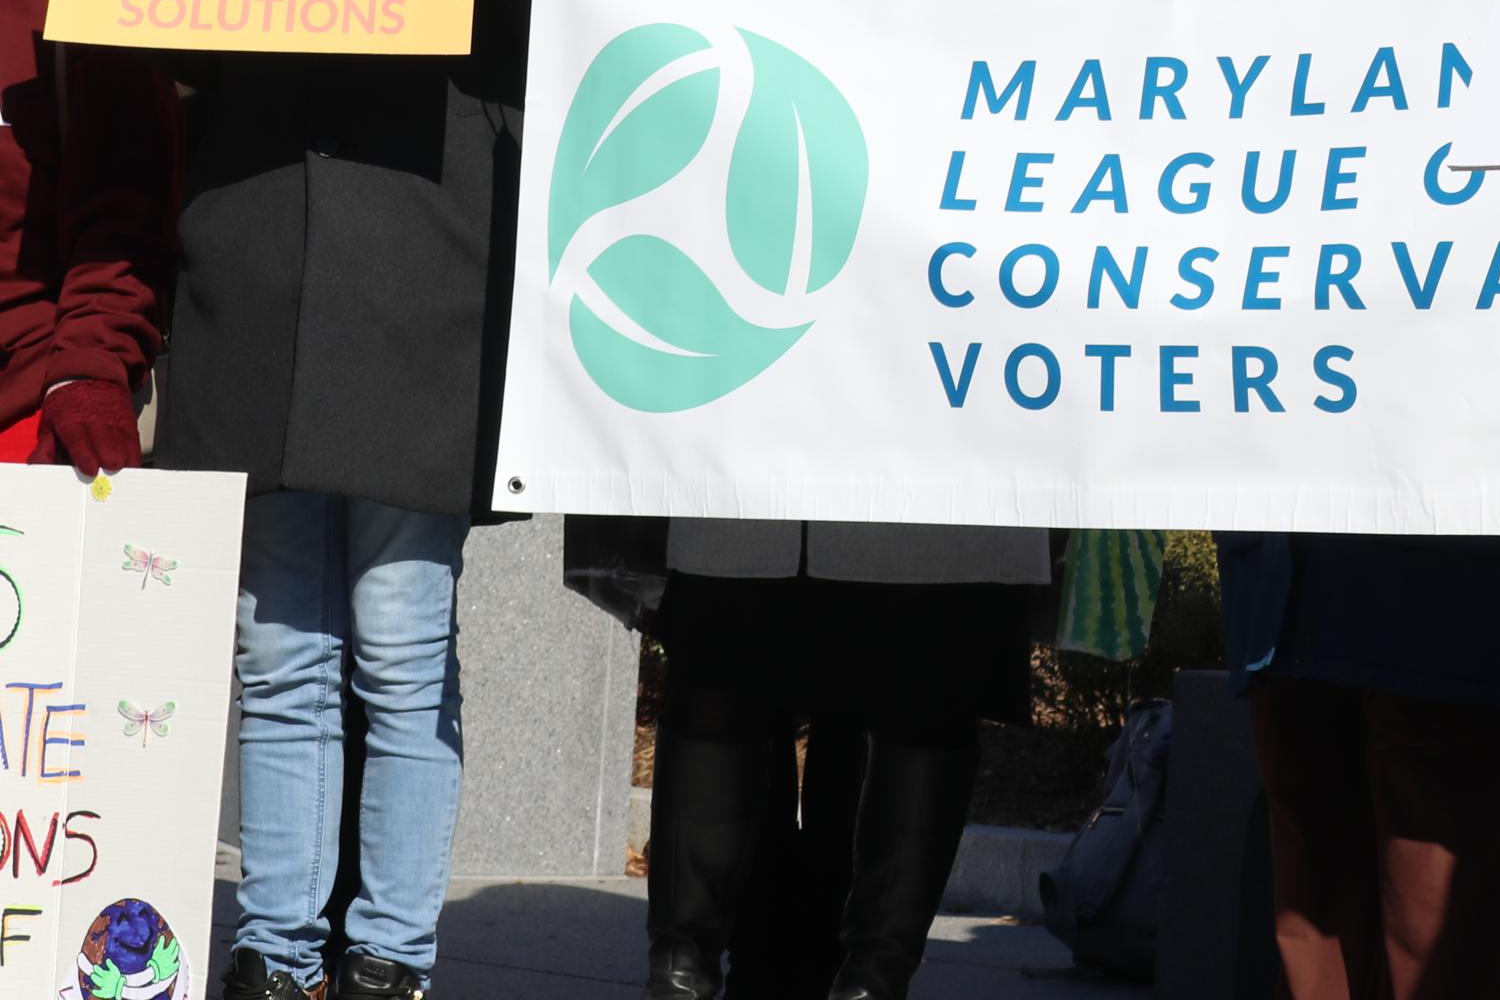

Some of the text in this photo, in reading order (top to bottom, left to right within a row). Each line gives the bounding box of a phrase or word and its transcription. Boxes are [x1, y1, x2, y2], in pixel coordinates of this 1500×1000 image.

[960, 42, 1473, 121] MARYLAN
[939, 146, 1368, 214] LEAGUE
[928, 341, 1358, 414] VOTERS
